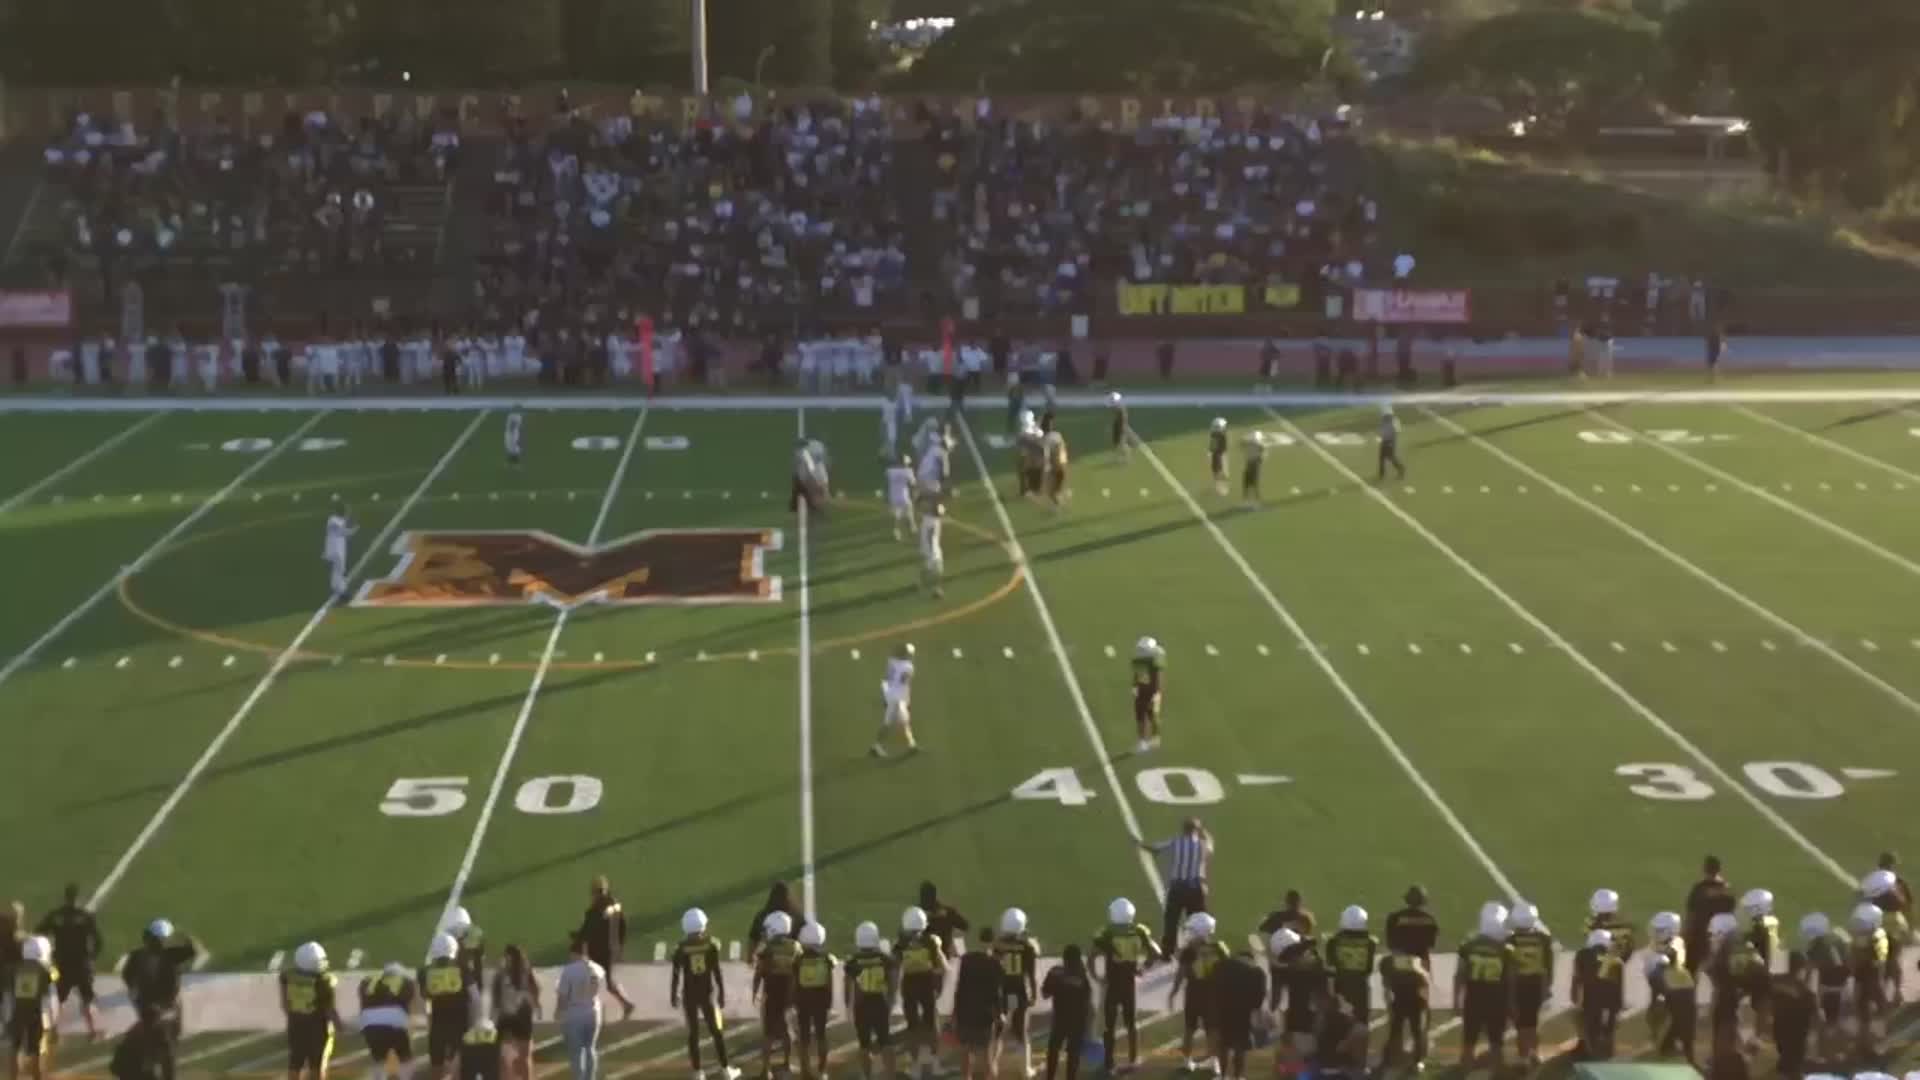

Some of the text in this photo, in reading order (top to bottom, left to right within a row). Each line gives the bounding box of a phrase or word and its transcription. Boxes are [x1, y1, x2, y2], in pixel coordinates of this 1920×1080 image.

[379, 774, 604, 816] 50
[1011, 767, 1225, 805] 40
[1615, 762, 1845, 800] 30
